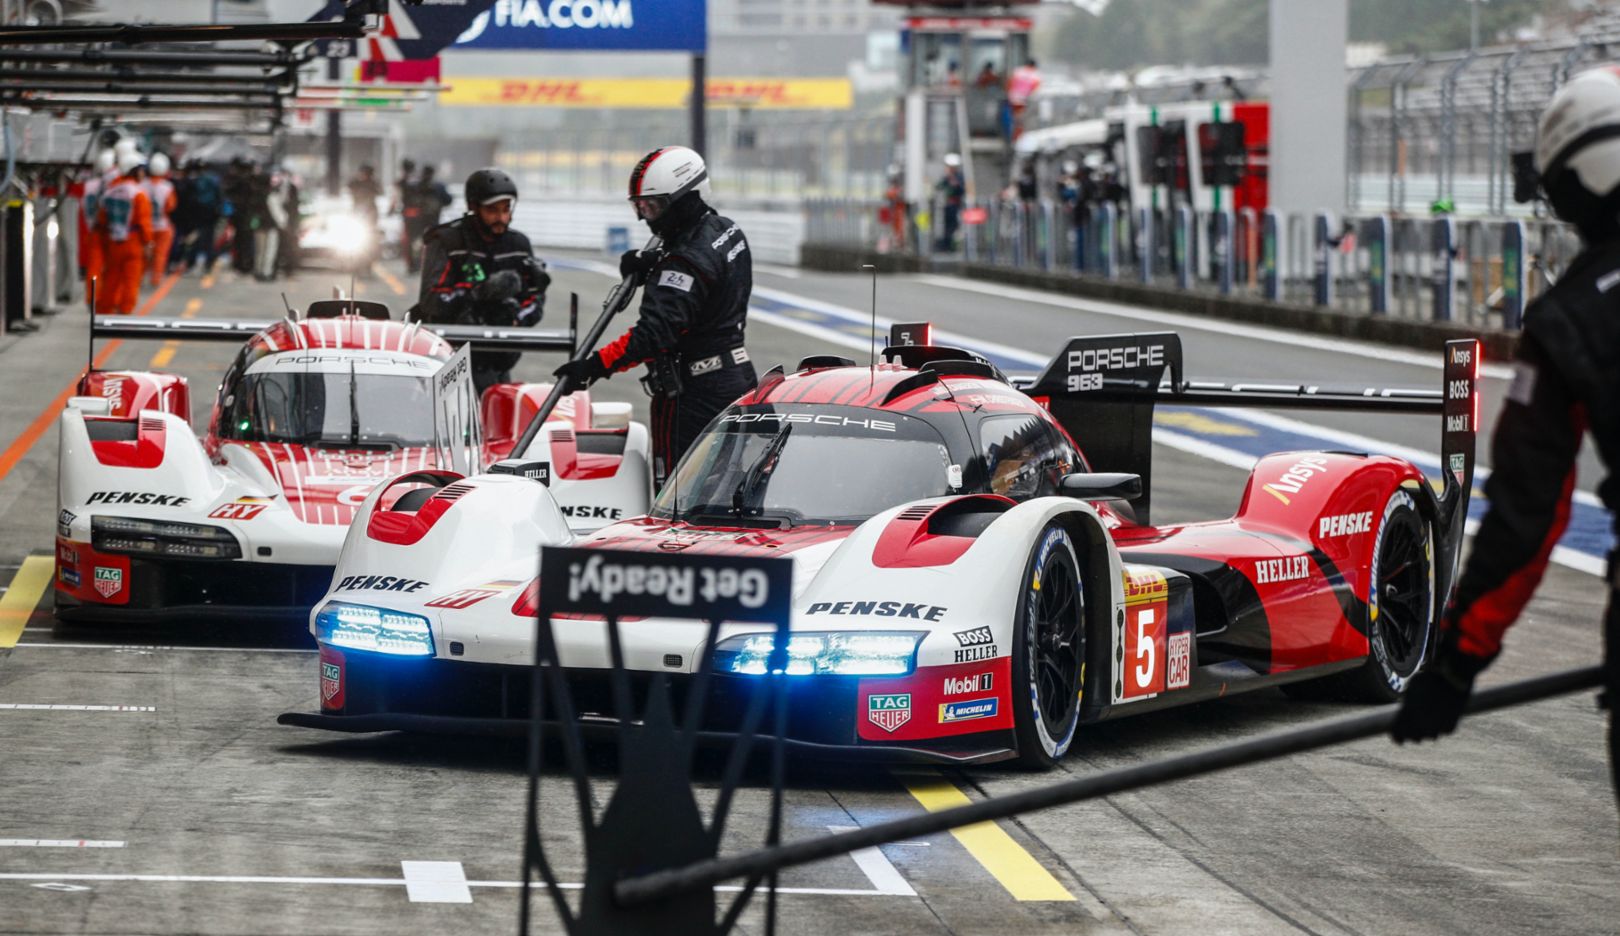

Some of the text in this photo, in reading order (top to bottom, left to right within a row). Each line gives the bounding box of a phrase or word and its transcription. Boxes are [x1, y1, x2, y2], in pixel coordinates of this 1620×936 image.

[494, 0, 633, 28] FIA.COM
[500, 79, 585, 100] DHL
[275, 355, 432, 370] PORSCHE
[1067, 345, 1165, 372] PORSCHE
[1450, 347, 1471, 367] Ansys
[1067, 373, 1104, 392] 963
[1449, 381, 1469, 399] BOSS
[719, 413, 896, 432] PORSCHE
[524, 468, 547, 479] HELLER
[1263, 456, 1328, 506] Ansys
[85, 491, 192, 507] PENSKE
[560, 505, 622, 520] NSKE
[1319, 511, 1373, 538] PENSKE
[96, 569, 120, 579] TAG
[1255, 556, 1309, 584] HELLER
[334, 575, 430, 593] PENSKE
[567, 554, 769, 608] Get Ready!
[1125, 574, 1163, 596] DHL
[805, 601, 948, 622] PENSKE
[956, 628, 991, 645] BOSS
[954, 645, 998, 662] HELLER
[1135, 608, 1155, 688] 5
[1169, 637, 1189, 656] HYPER
[323, 664, 338, 679] TAG
[1169, 655, 1189, 684] CAR
[944, 674, 980, 695] Mobil
[872, 697, 908, 709] TAG
[956, 703, 993, 716] MICHELIN
[871, 709, 909, 730] HEUER
